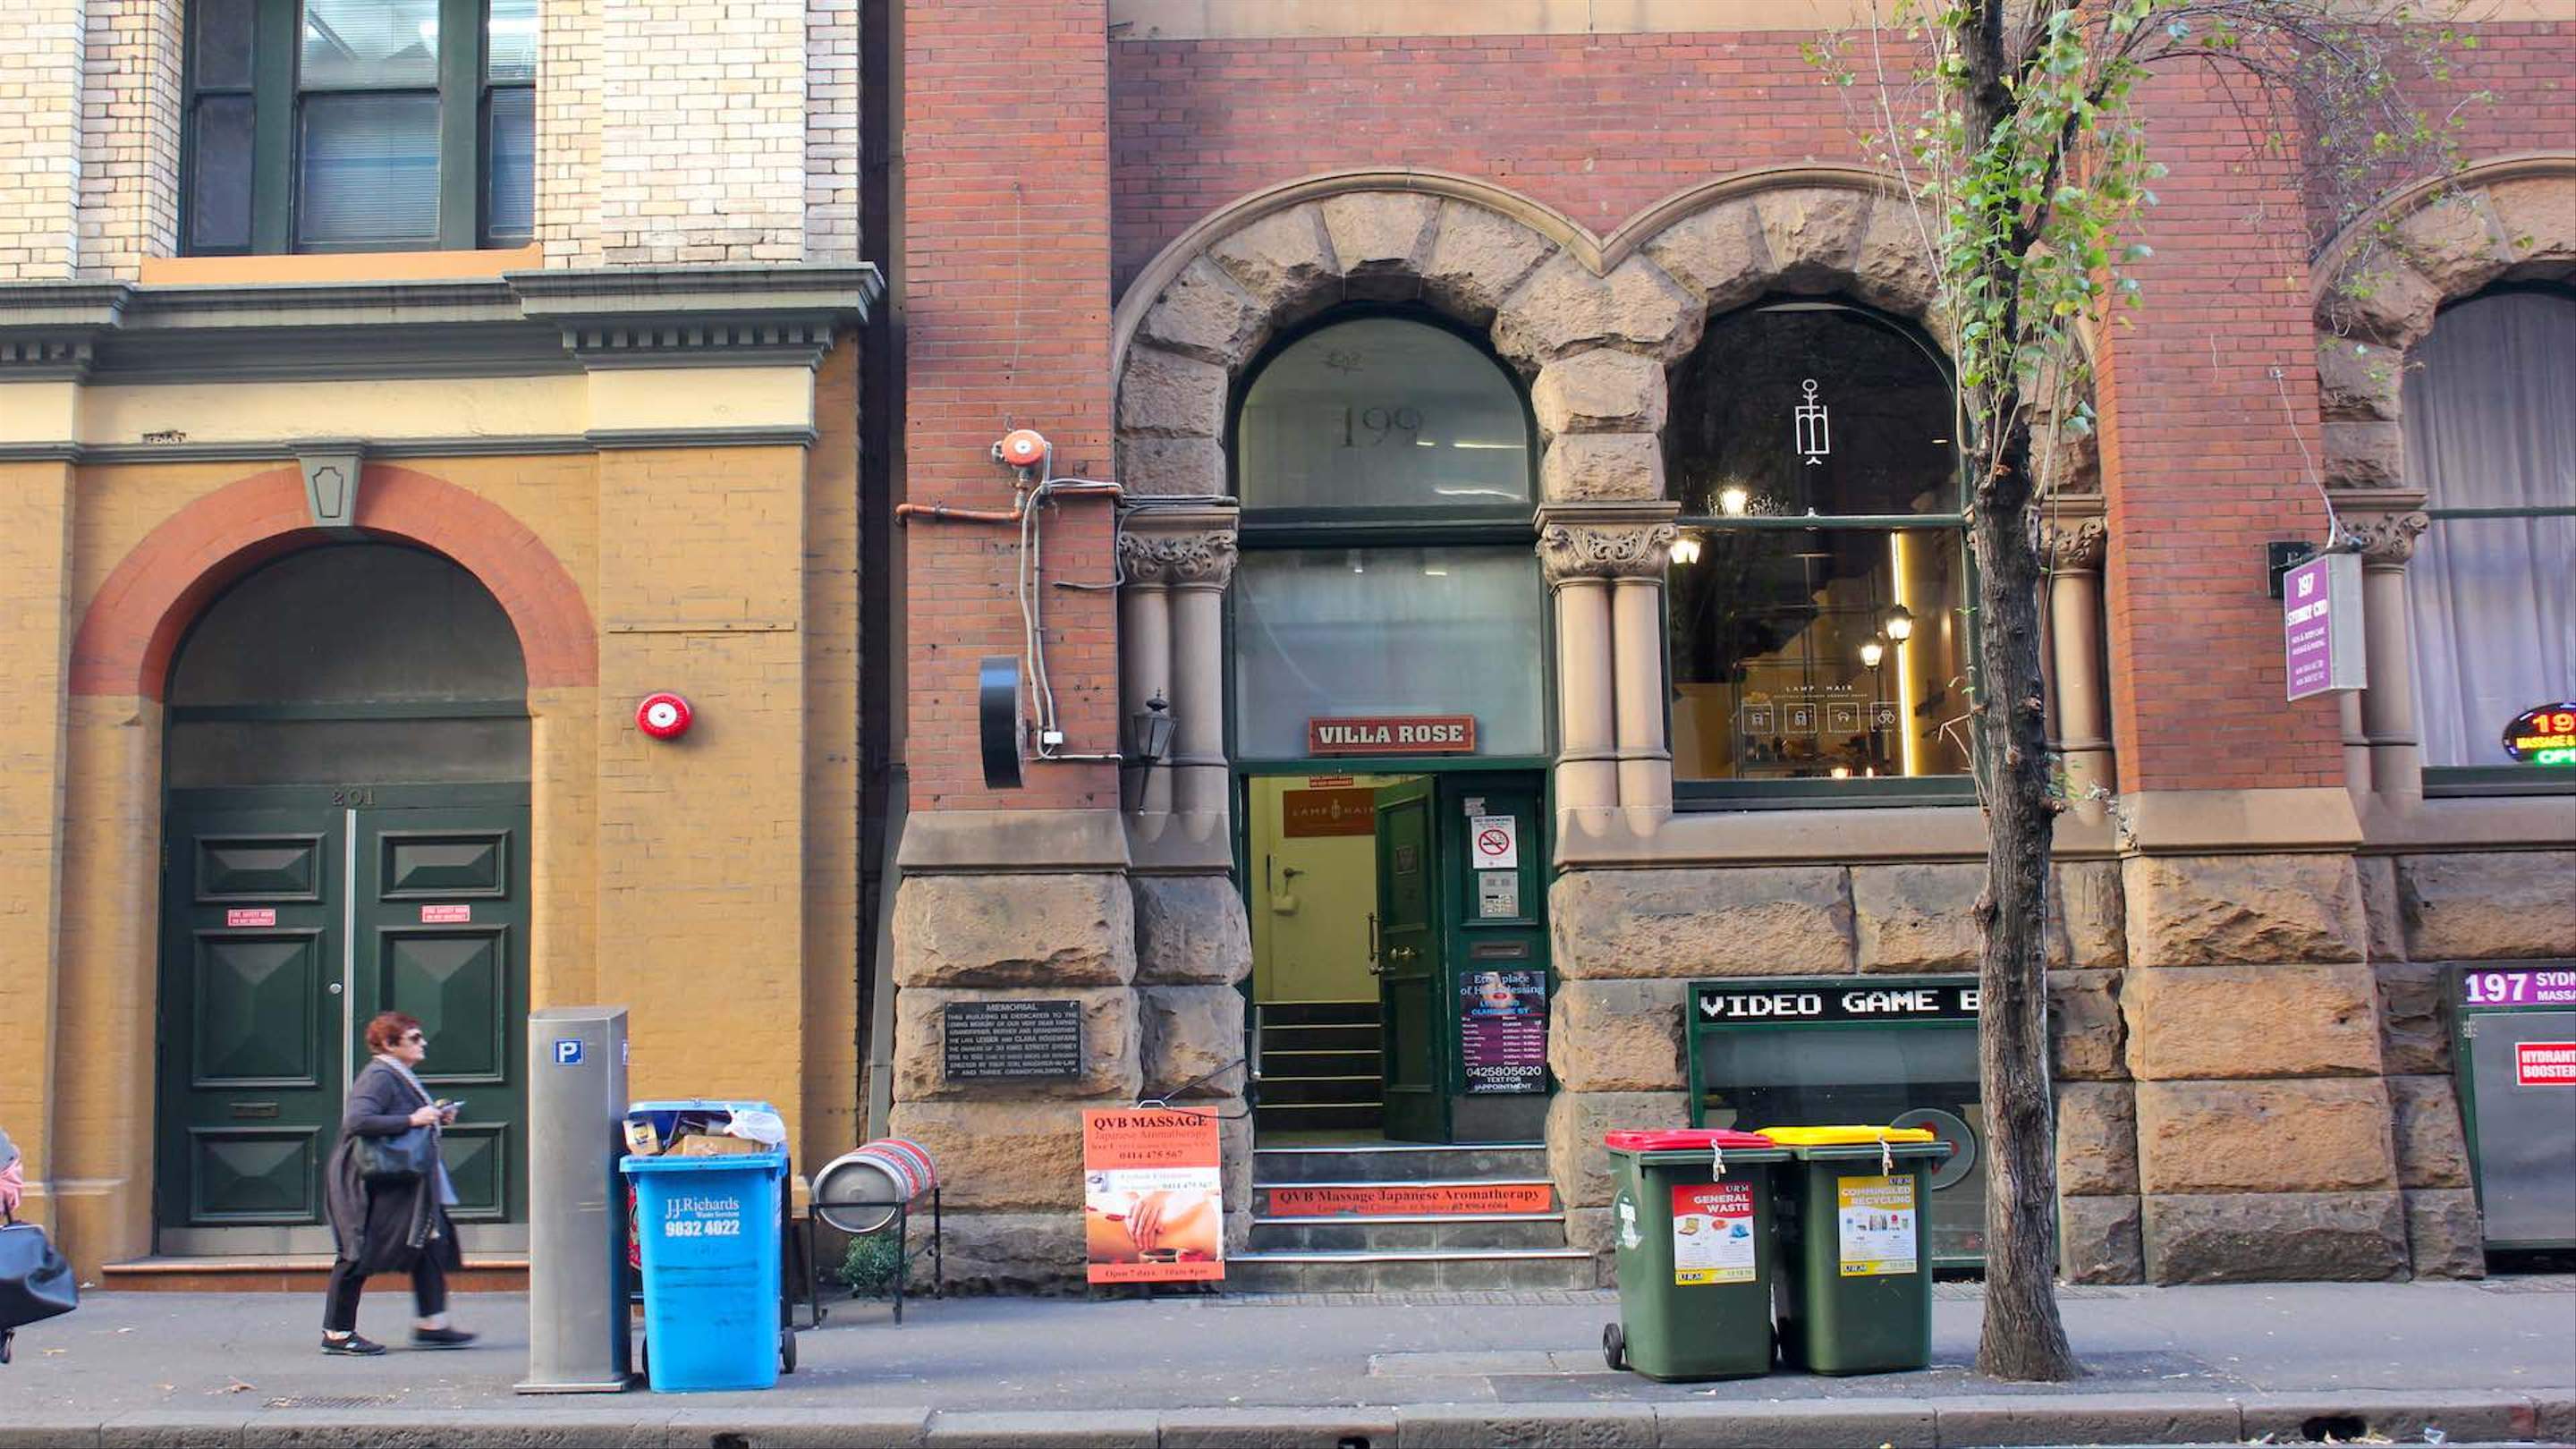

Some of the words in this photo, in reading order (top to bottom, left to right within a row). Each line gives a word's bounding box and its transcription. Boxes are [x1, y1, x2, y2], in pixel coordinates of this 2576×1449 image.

[2533, 713, 2576, 733] 19
[1318, 724, 1390, 744] VILLA
[1398, 724, 1463, 743] ROSE
[332, 787, 376, 806] 201
[2465, 973, 2528, 1003] 197
[1700, 993, 1822, 1017] VIDEO
[1842, 989, 1939, 1013] GAME
[558, 1042, 578, 1063] P
[2521, 1050, 2576, 1063] HYDRANT
[2523, 1064, 2576, 1078] BOOSTER
[1094, 1117, 1127, 1130] QVB
[1131, 1115, 1208, 1128] MASSAGE
[1280, 1191, 1313, 1203] QVB
[1318, 1191, 1375, 1202] Massage
[1378, 1191, 1439, 1203] Japanese
[1445, 1189, 1539, 1201] Aromatherapy
[1693, 1193, 1750, 1204] GENERAL
[1707, 1203, 1750, 1213] WASTE
